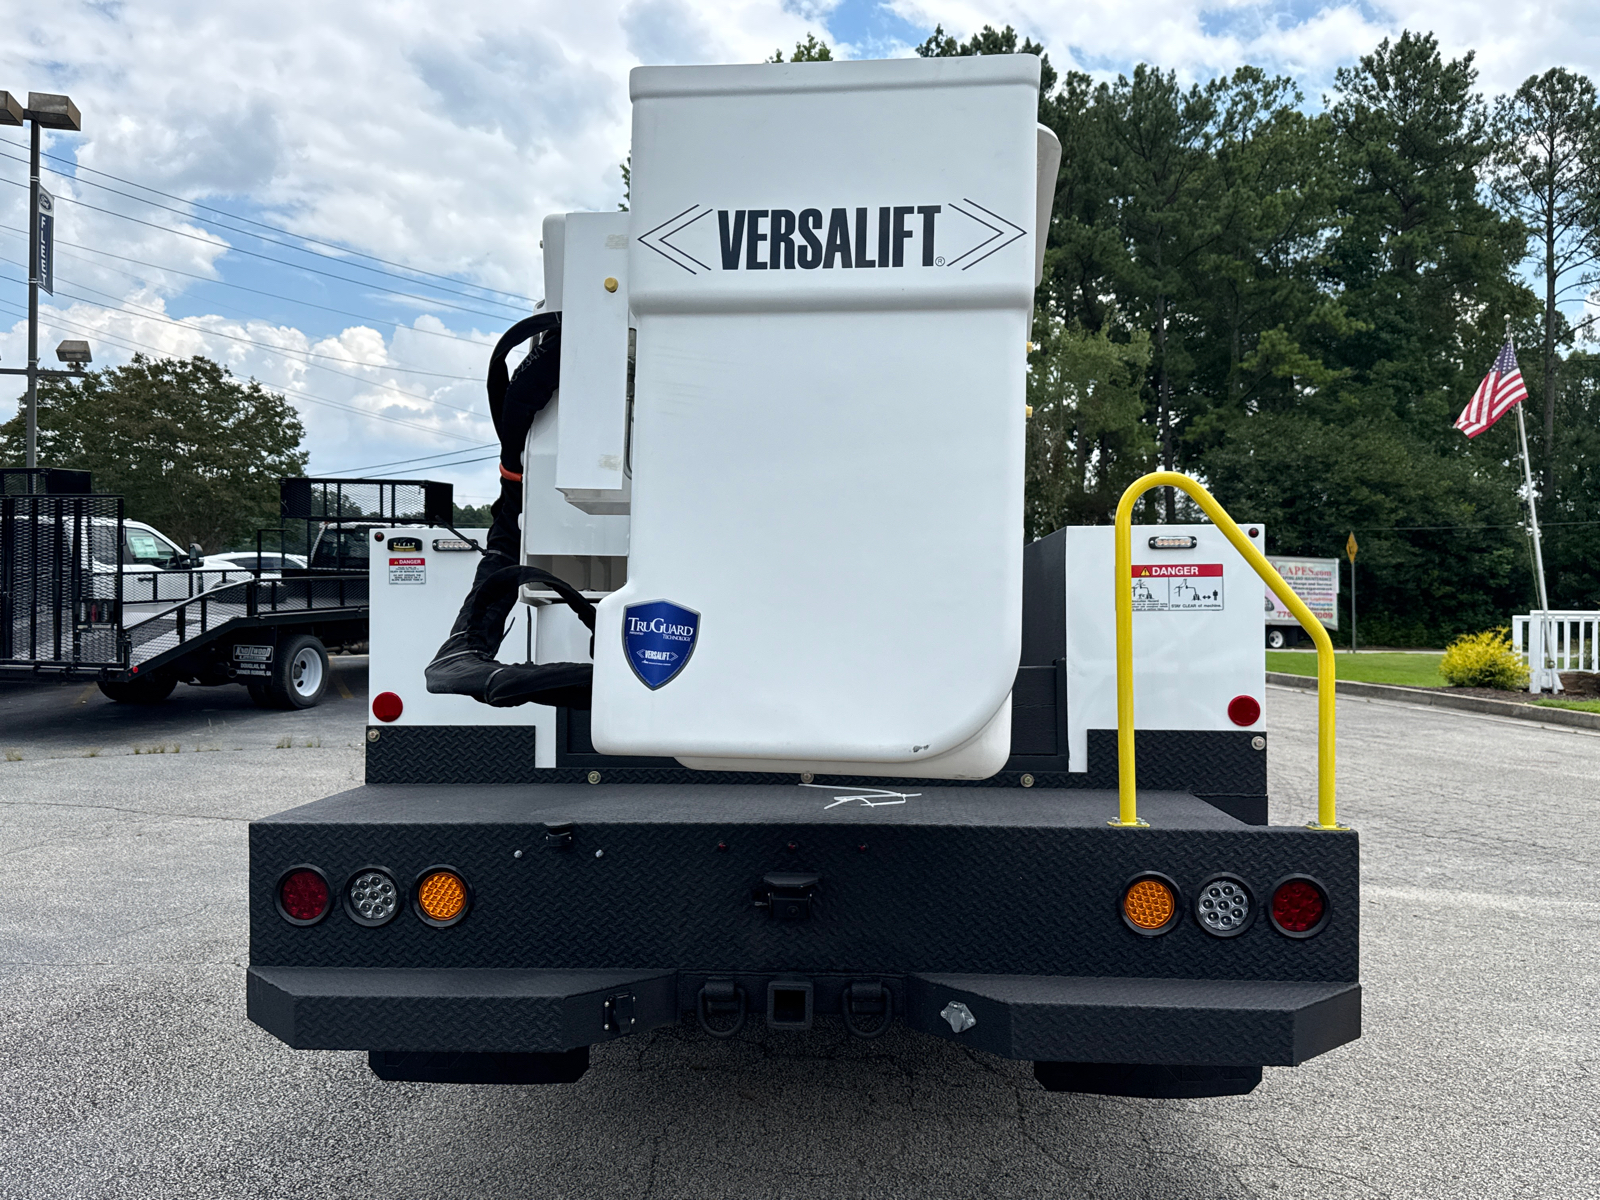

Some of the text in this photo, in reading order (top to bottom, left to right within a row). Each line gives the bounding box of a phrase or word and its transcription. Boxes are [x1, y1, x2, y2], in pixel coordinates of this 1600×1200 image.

[717, 205, 942, 270] VERSALIFT
[39, 215, 47, 287] FLEET
[1152, 567, 1198, 576] DANGER
[662, 634, 692, 642] TECHNOLOGY
[644, 650, 670, 661] VERSALIFT
